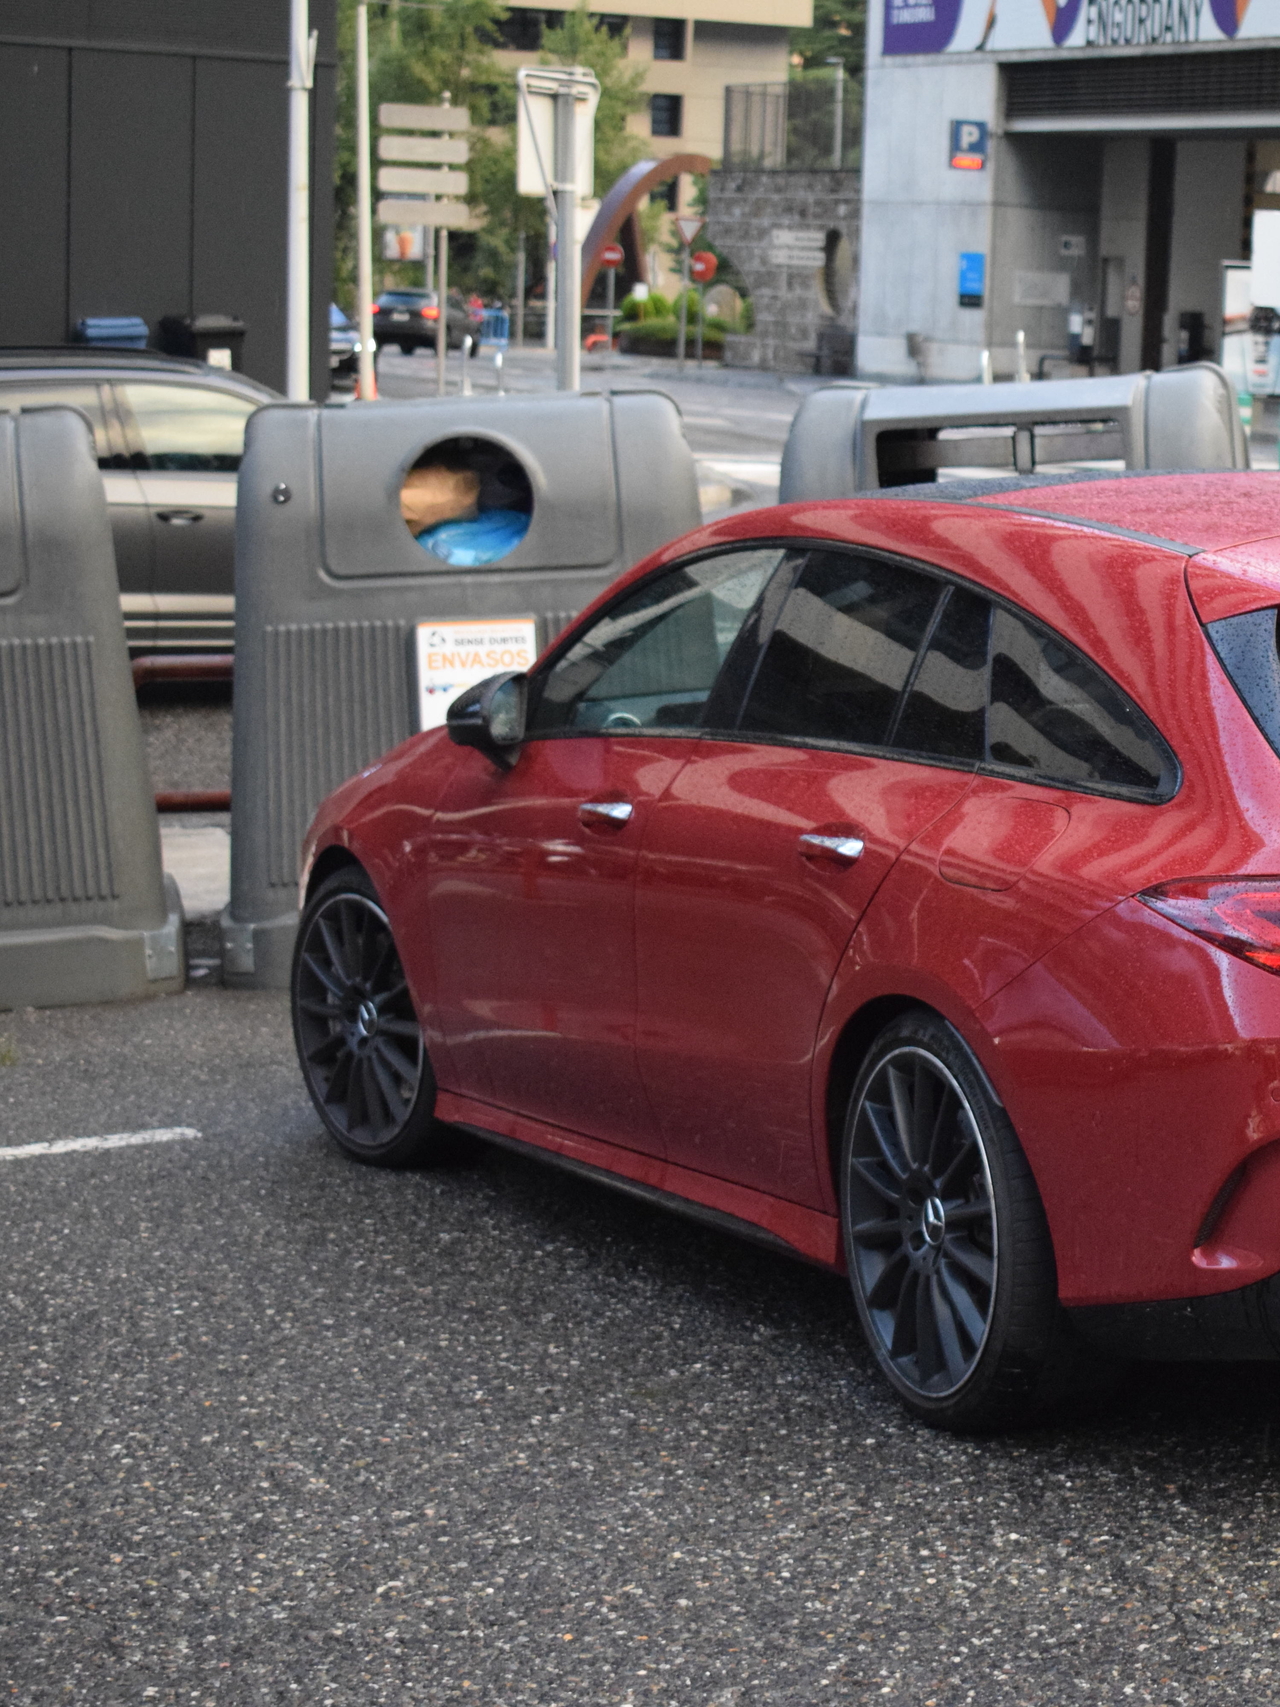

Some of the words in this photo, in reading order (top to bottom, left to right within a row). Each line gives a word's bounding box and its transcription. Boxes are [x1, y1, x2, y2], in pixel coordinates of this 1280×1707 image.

[1086, 0, 1202, 45] ENGORDANY
[962, 124, 980, 150] P
[454, 637, 487, 647] SENSE
[489, 636, 527, 646] DUBTES
[427, 649, 530, 670] ENVASOS
